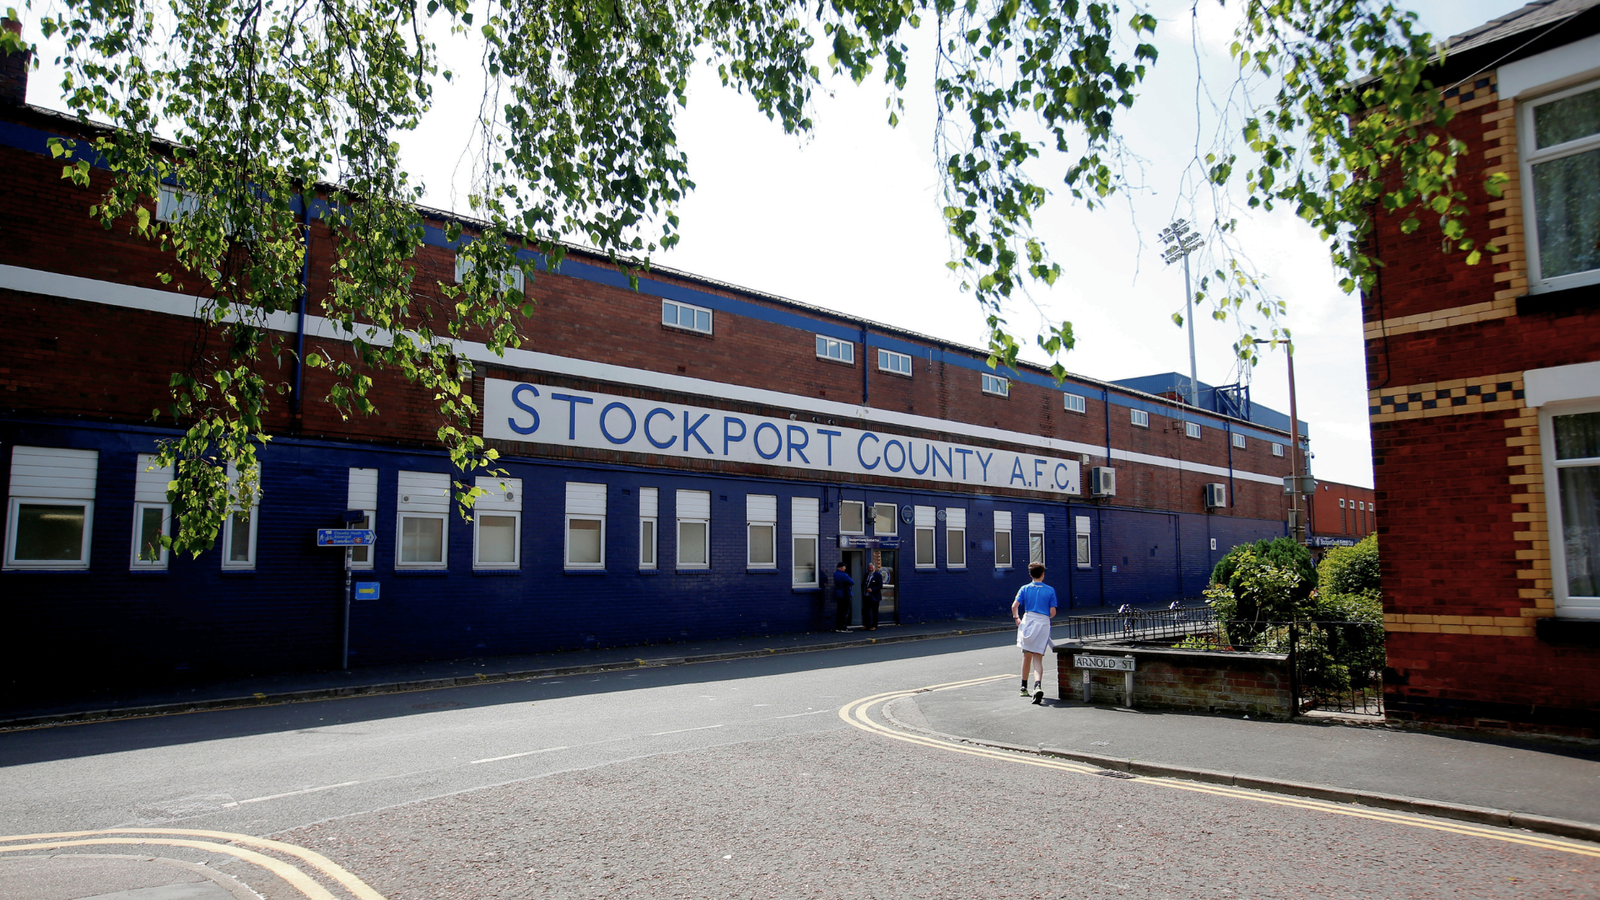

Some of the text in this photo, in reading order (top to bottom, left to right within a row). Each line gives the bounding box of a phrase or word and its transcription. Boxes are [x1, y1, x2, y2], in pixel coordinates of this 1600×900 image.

[508, 383, 1075, 491] STOCKPORT COUNTY A.F.C.
[1076, 658, 1133, 669] ARNOLD ST
